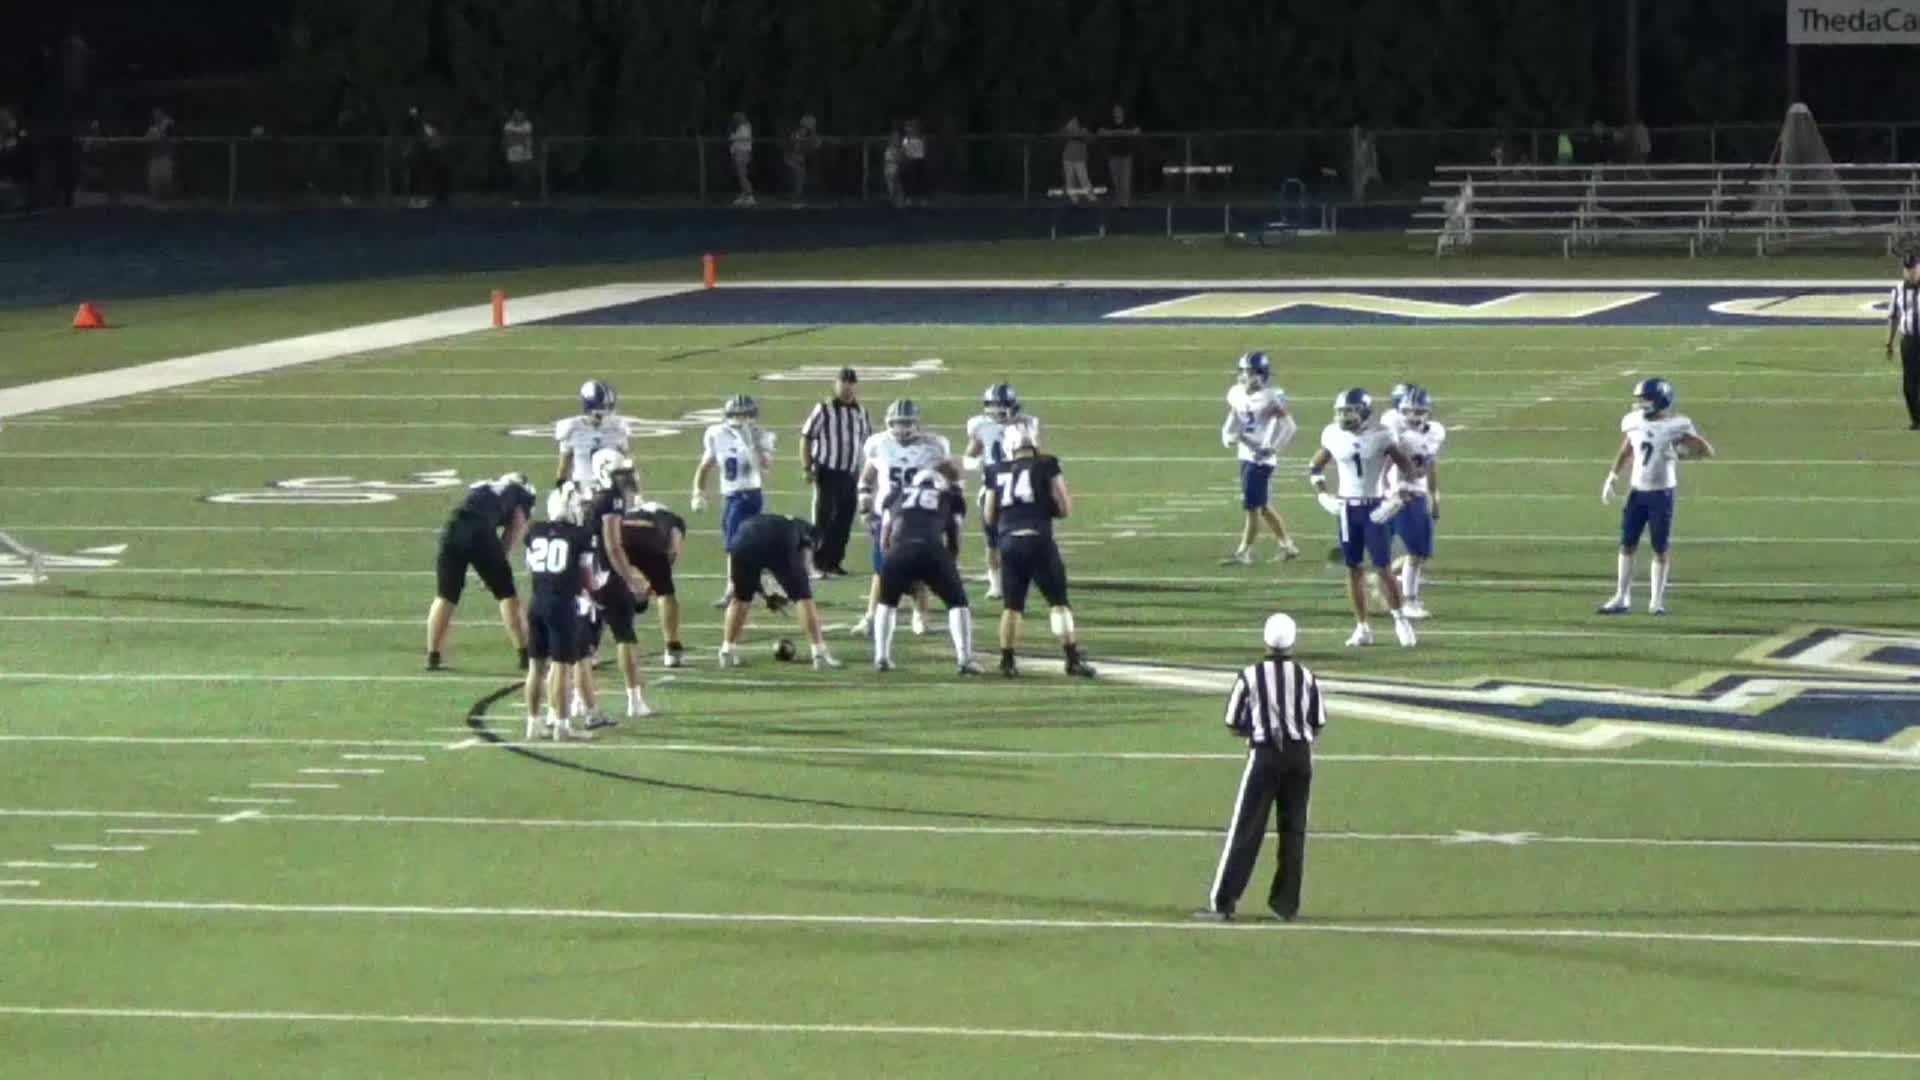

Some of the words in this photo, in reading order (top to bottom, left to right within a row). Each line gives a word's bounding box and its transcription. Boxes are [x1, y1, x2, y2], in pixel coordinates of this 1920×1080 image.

[1352, 452, 1363, 478] 1
[1641, 441, 1654, 466] 7
[996, 469, 1035, 507] 74
[530, 537, 568, 574] 20
